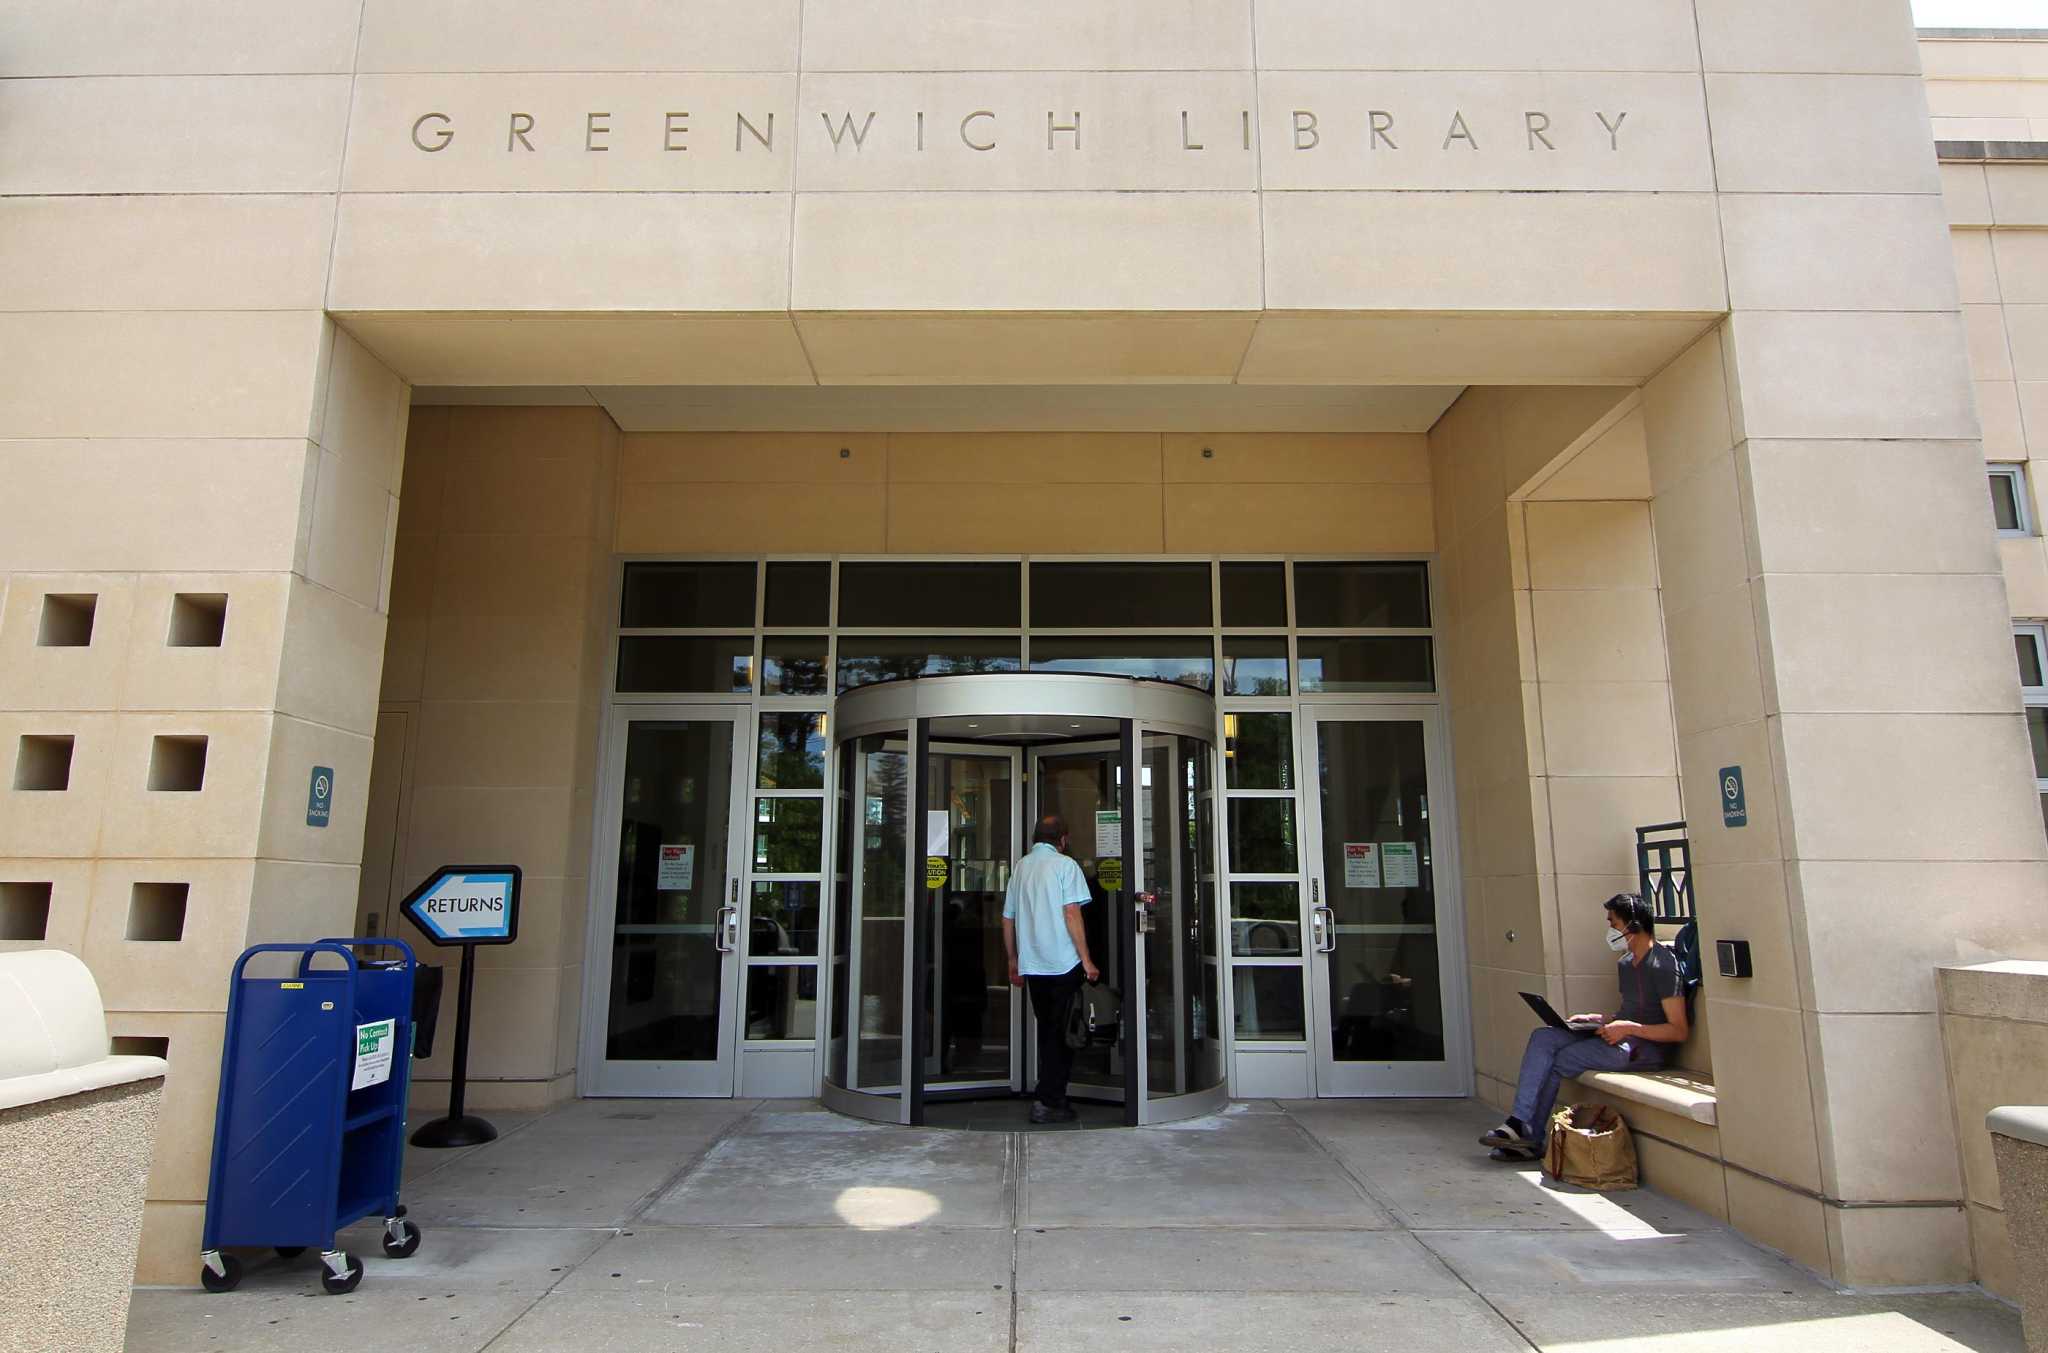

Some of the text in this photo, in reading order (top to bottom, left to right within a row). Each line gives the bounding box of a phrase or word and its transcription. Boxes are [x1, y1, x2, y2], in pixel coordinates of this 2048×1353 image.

[410, 110, 1627, 153] GREENWICH LIBRARY
[309, 809, 329, 818] SMOKING
[1724, 809, 1745, 818] SMOKING
[427, 897, 504, 913] RETURNS
[360, 1030, 369, 1039] No
[360, 1041, 379, 1053] Pick Up
